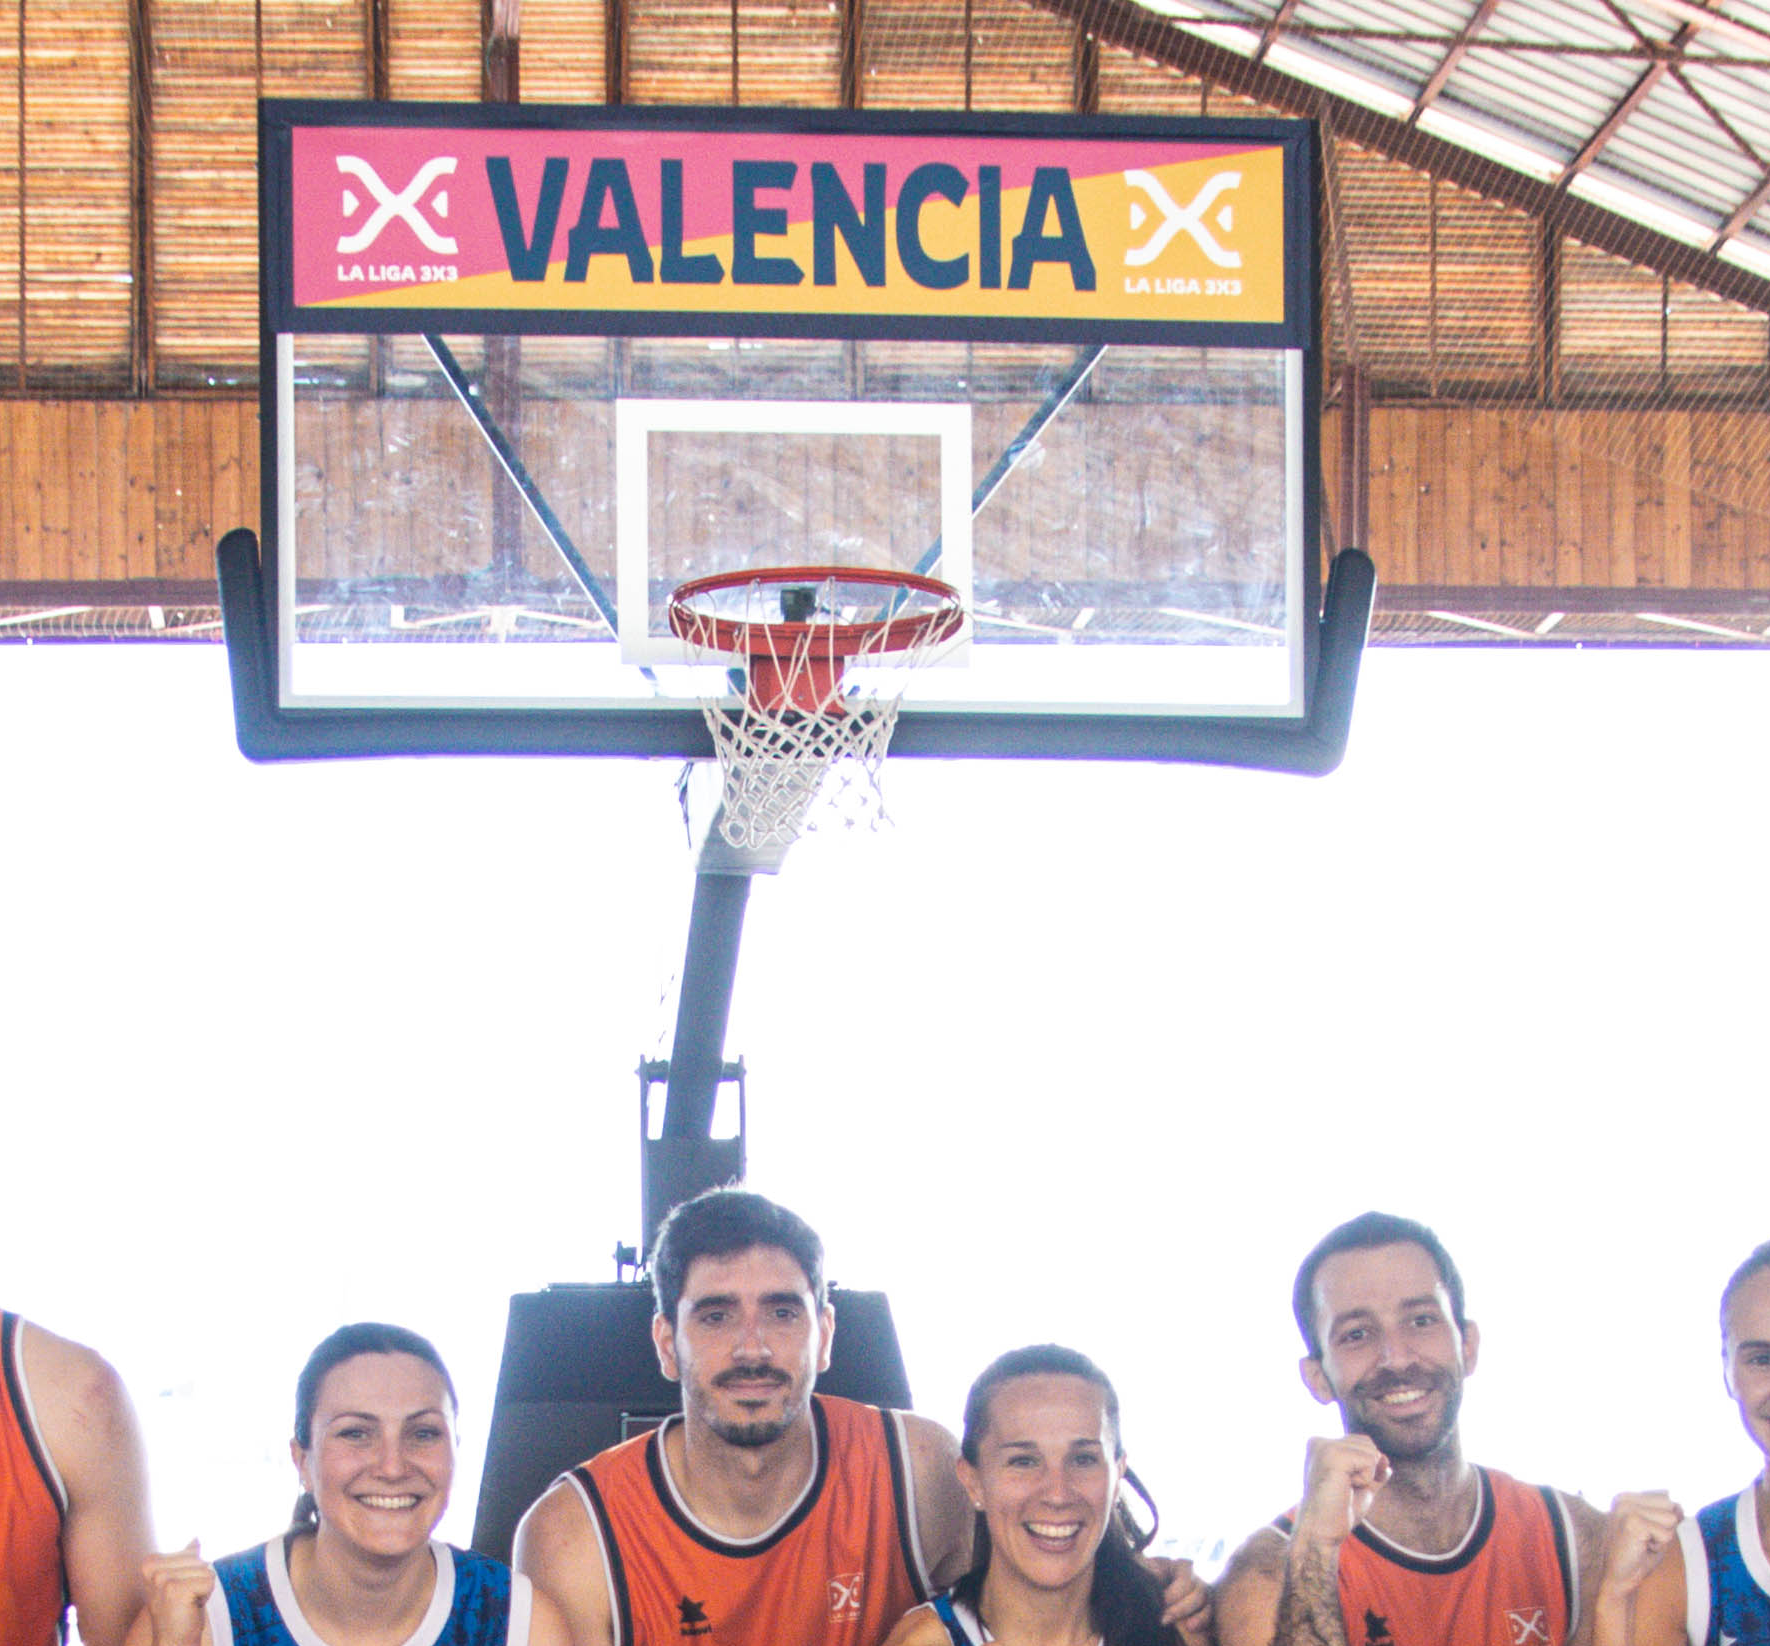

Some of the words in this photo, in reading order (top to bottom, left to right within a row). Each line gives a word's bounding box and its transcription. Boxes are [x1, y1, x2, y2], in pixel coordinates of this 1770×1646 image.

[485, 155, 1098, 292] VALENCIA
[337, 265, 365, 282] LA
[369, 265, 415, 283] LIGA
[419, 265, 458, 283] 3X3
[1124, 277, 1150, 294] LA
[1155, 278, 1201, 296] LIGA
[1205, 279, 1243, 296] 3X3
